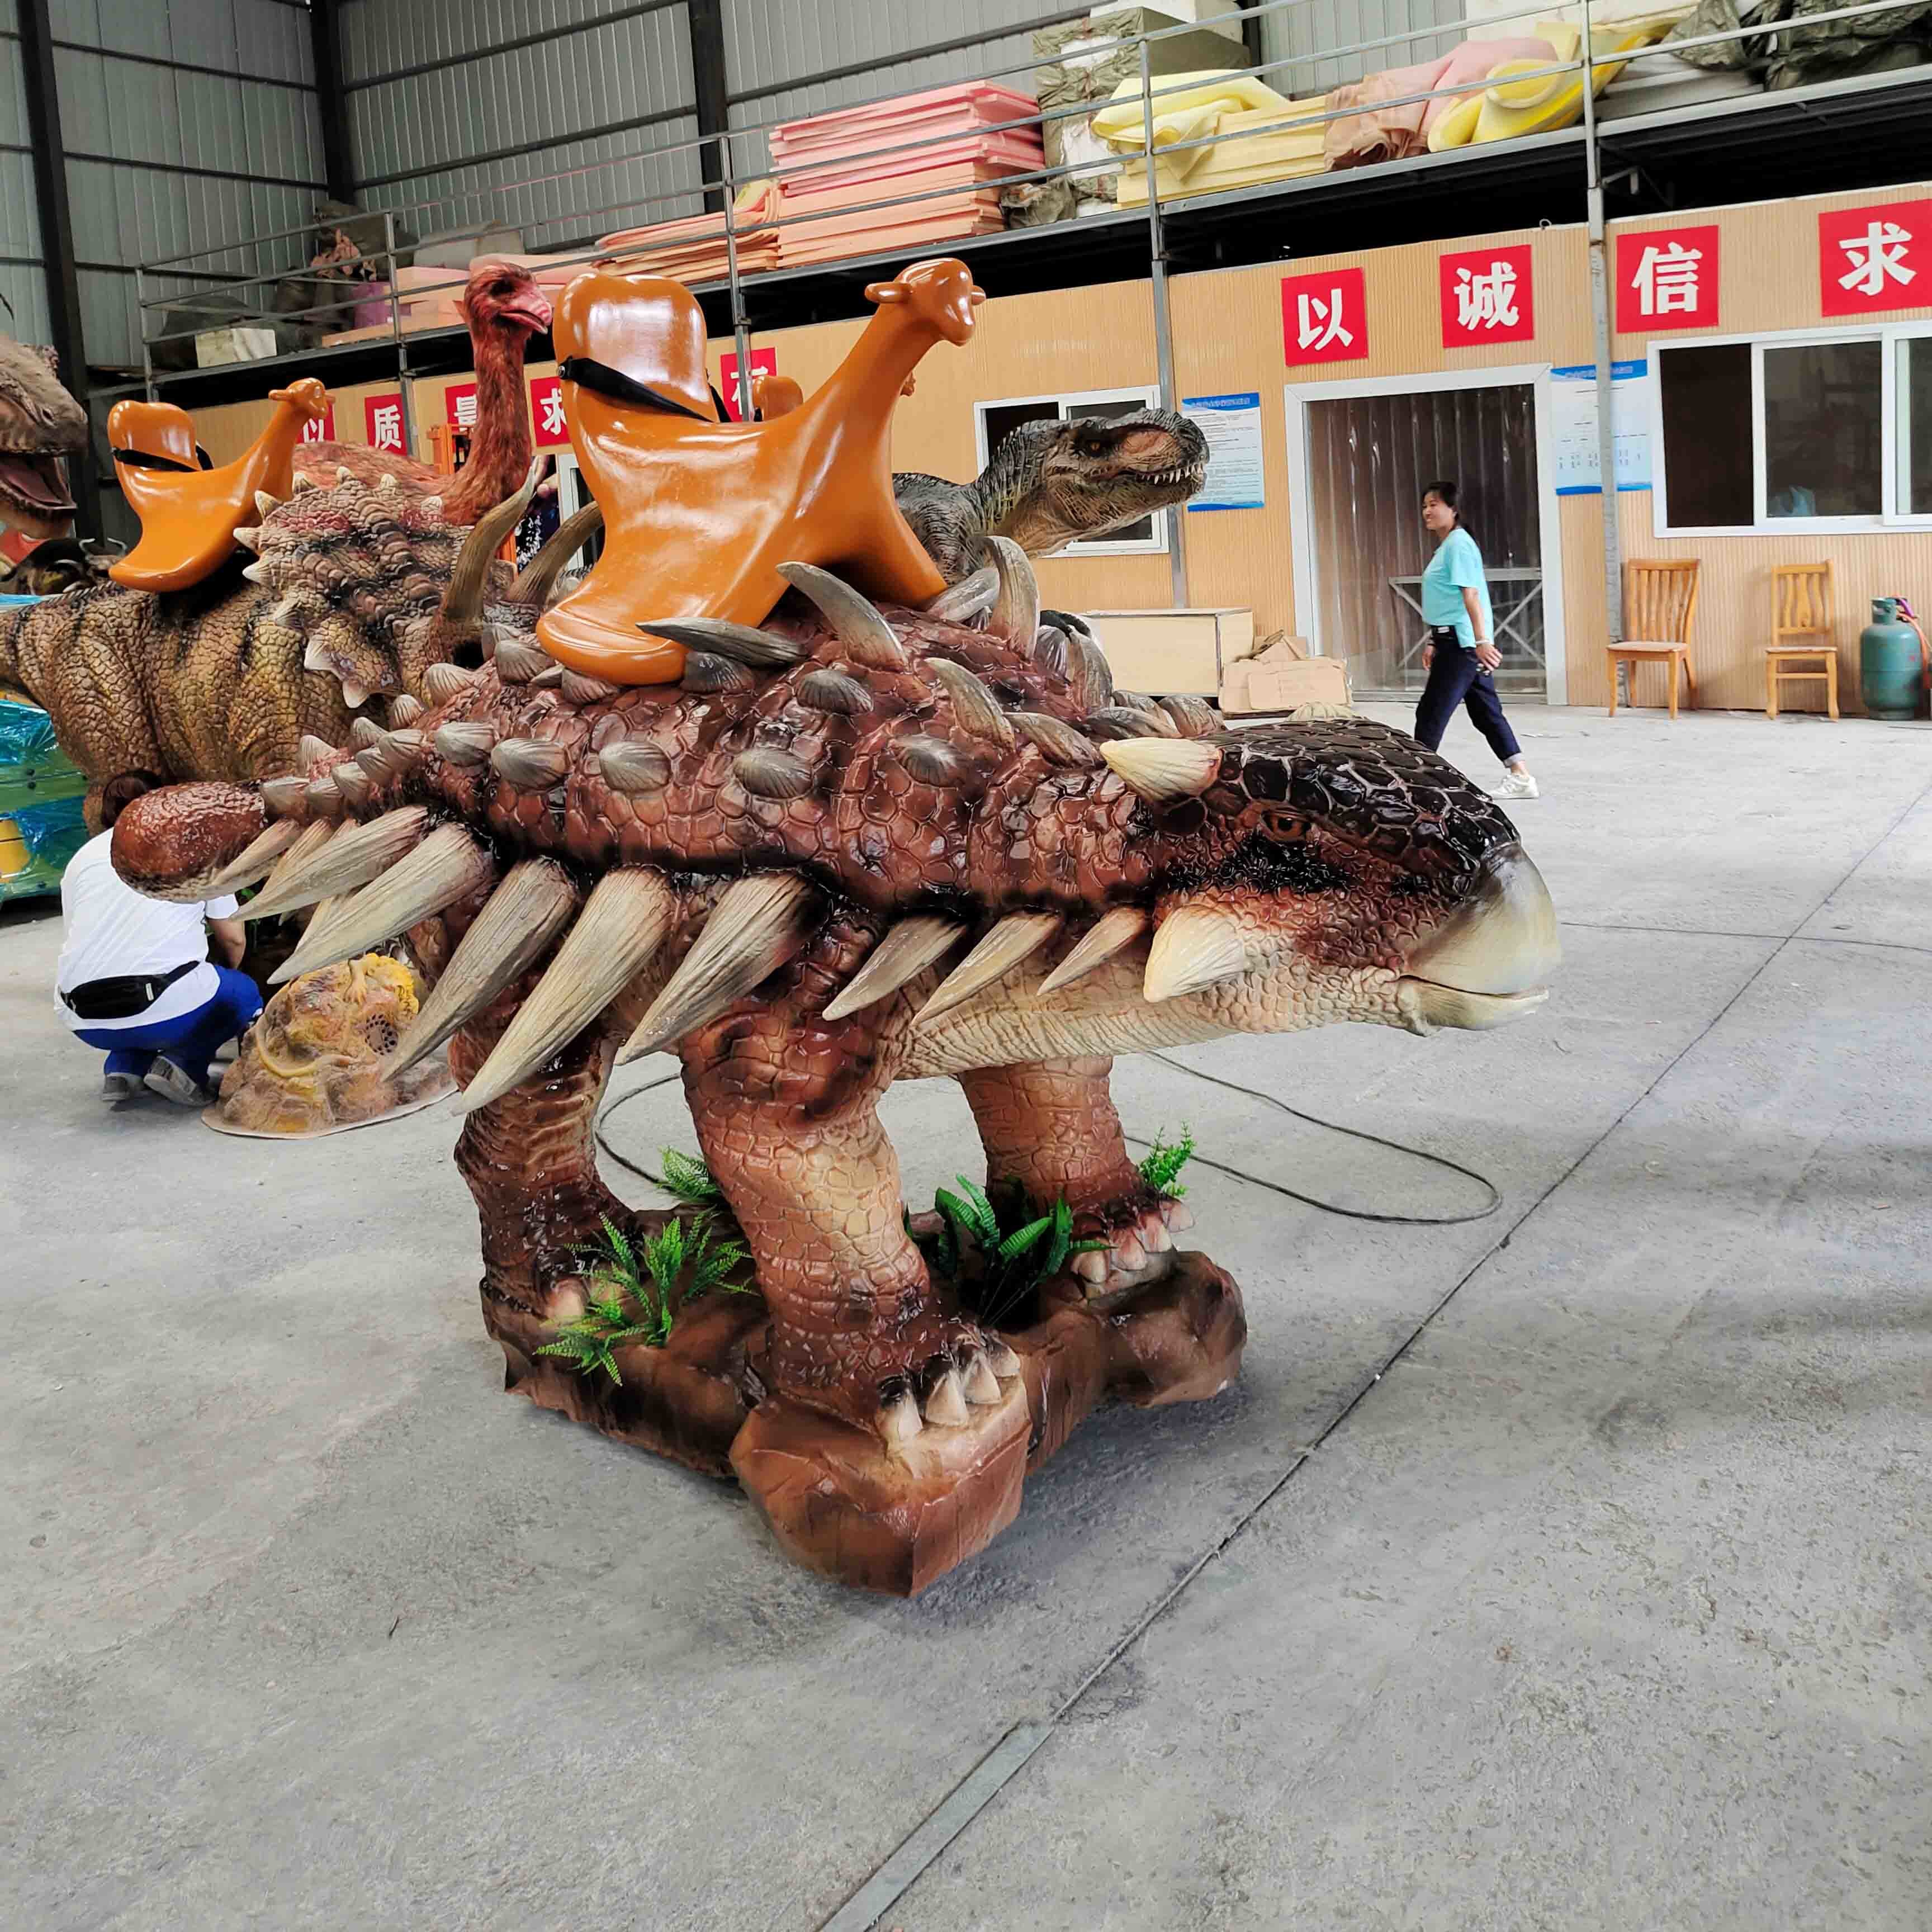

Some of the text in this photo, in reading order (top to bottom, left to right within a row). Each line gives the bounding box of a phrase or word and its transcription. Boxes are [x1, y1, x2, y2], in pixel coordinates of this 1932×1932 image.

[1298, 221, 1917, 351] 以 诚 信 求
[373, 404, 402, 450] 质
